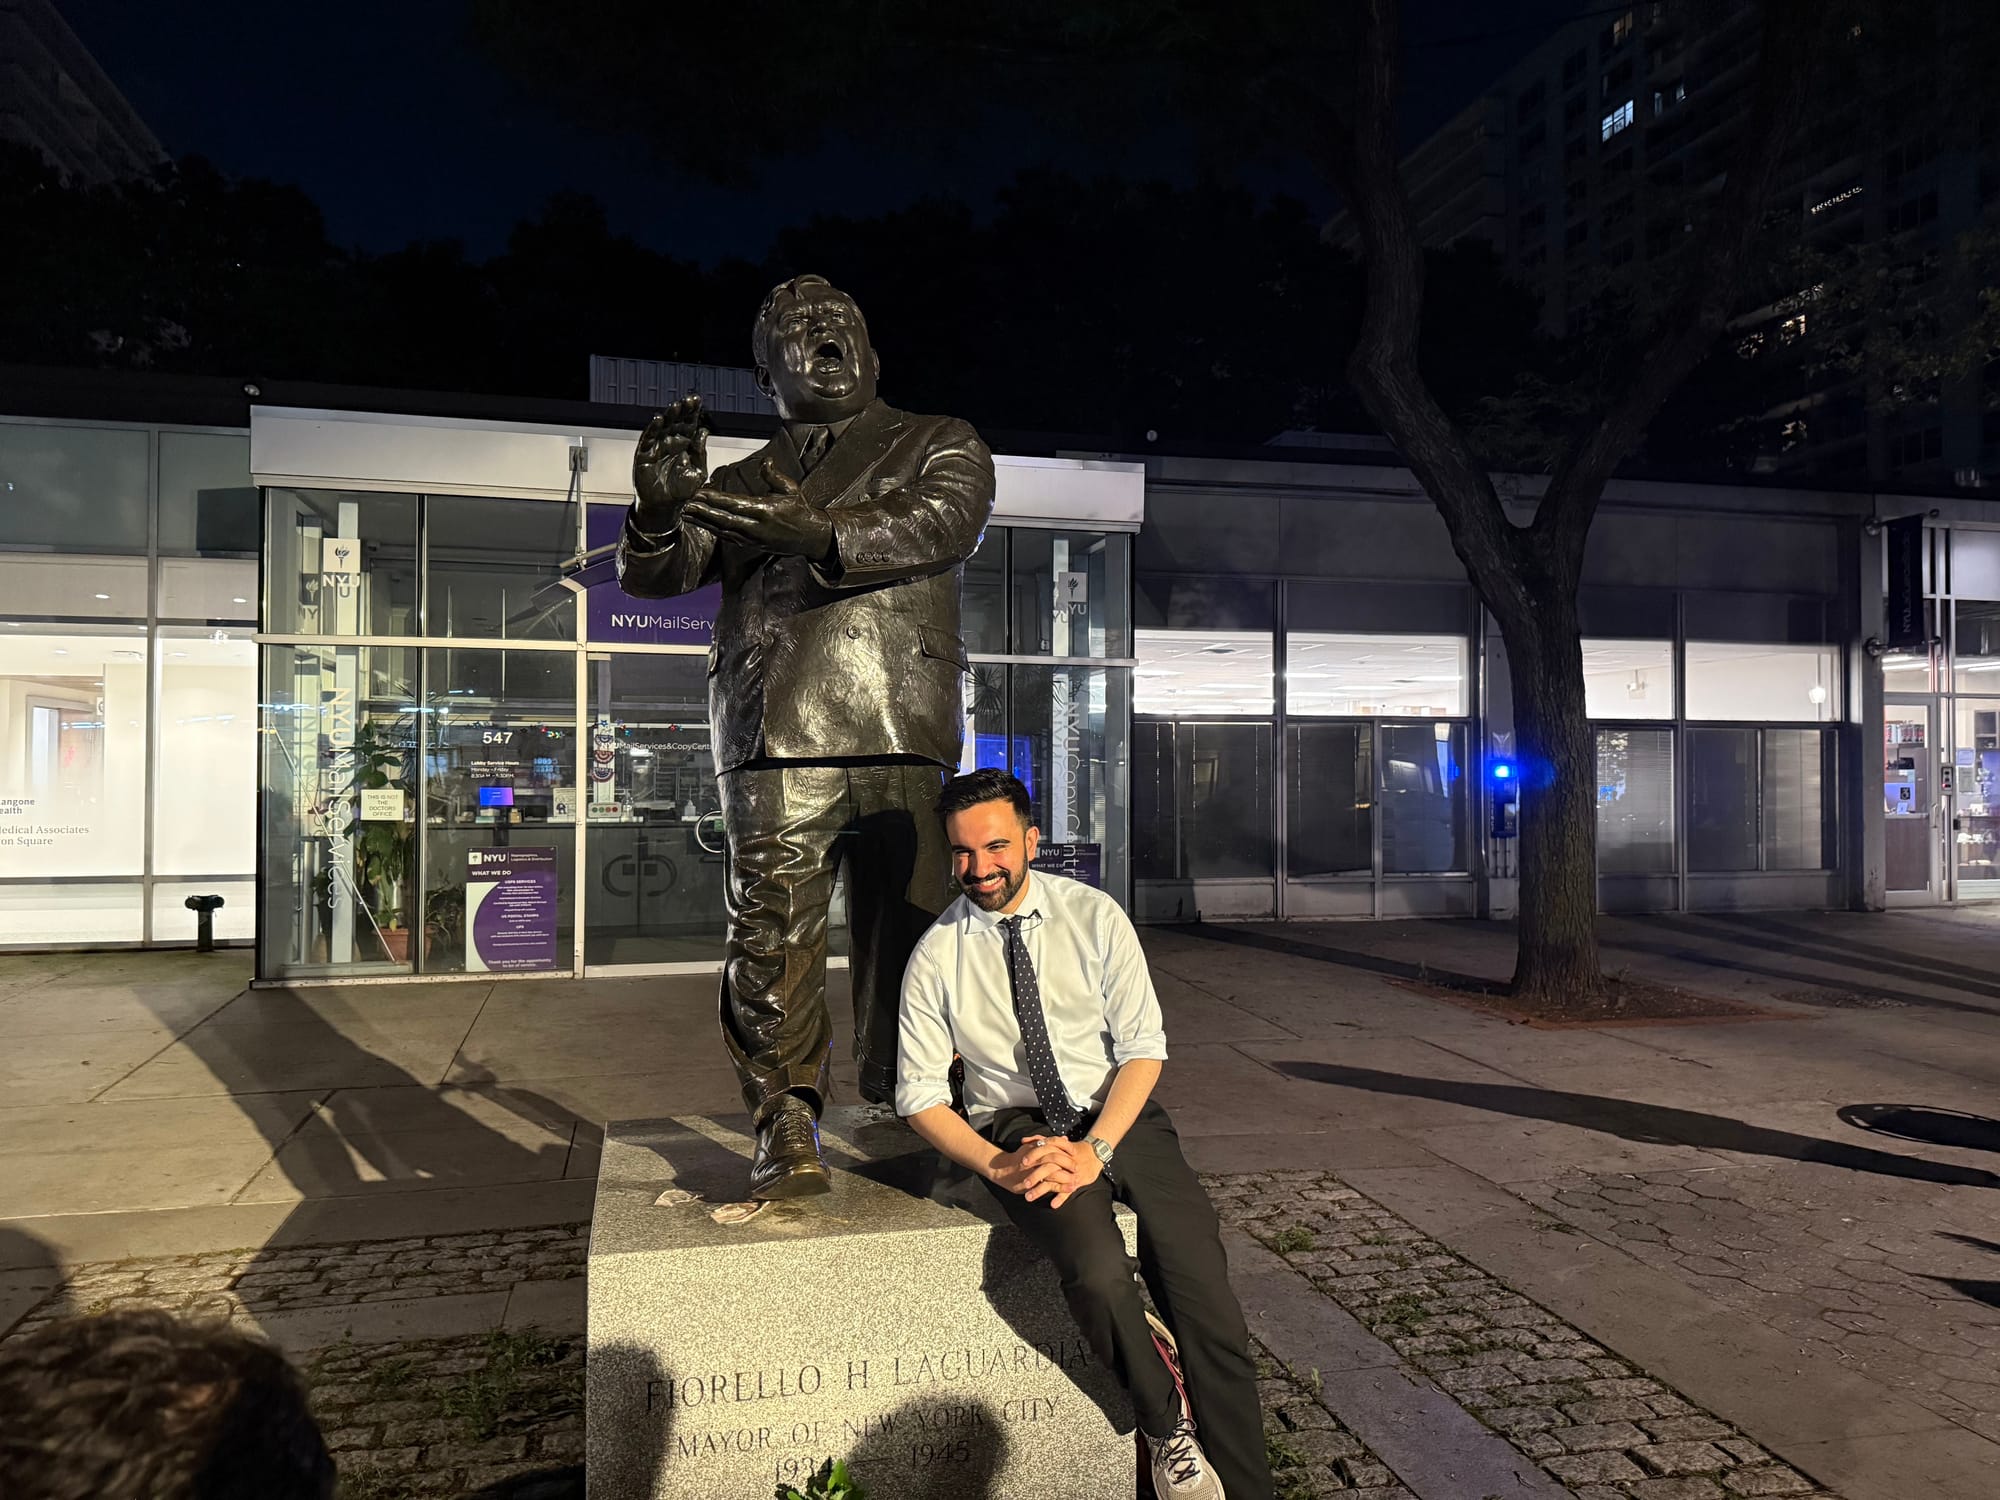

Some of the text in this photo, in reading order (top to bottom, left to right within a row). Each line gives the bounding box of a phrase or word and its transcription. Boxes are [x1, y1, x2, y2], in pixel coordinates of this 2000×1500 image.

[322, 574, 360, 588] NYU
[482, 731, 513, 744] 547
[327, 687, 352, 909] NYUMailServices
[36, 826, 89, 834] Associates
[17, 837, 53, 847] Square
[483, 853, 506, 862] NYU
[647, 1340, 1088, 1411] FIORELLO H LAGUARDIA
[677, 1397, 1059, 1458] MAYOR OF NEW YORK CITY
[911, 1441, 970, 1468] 1945
